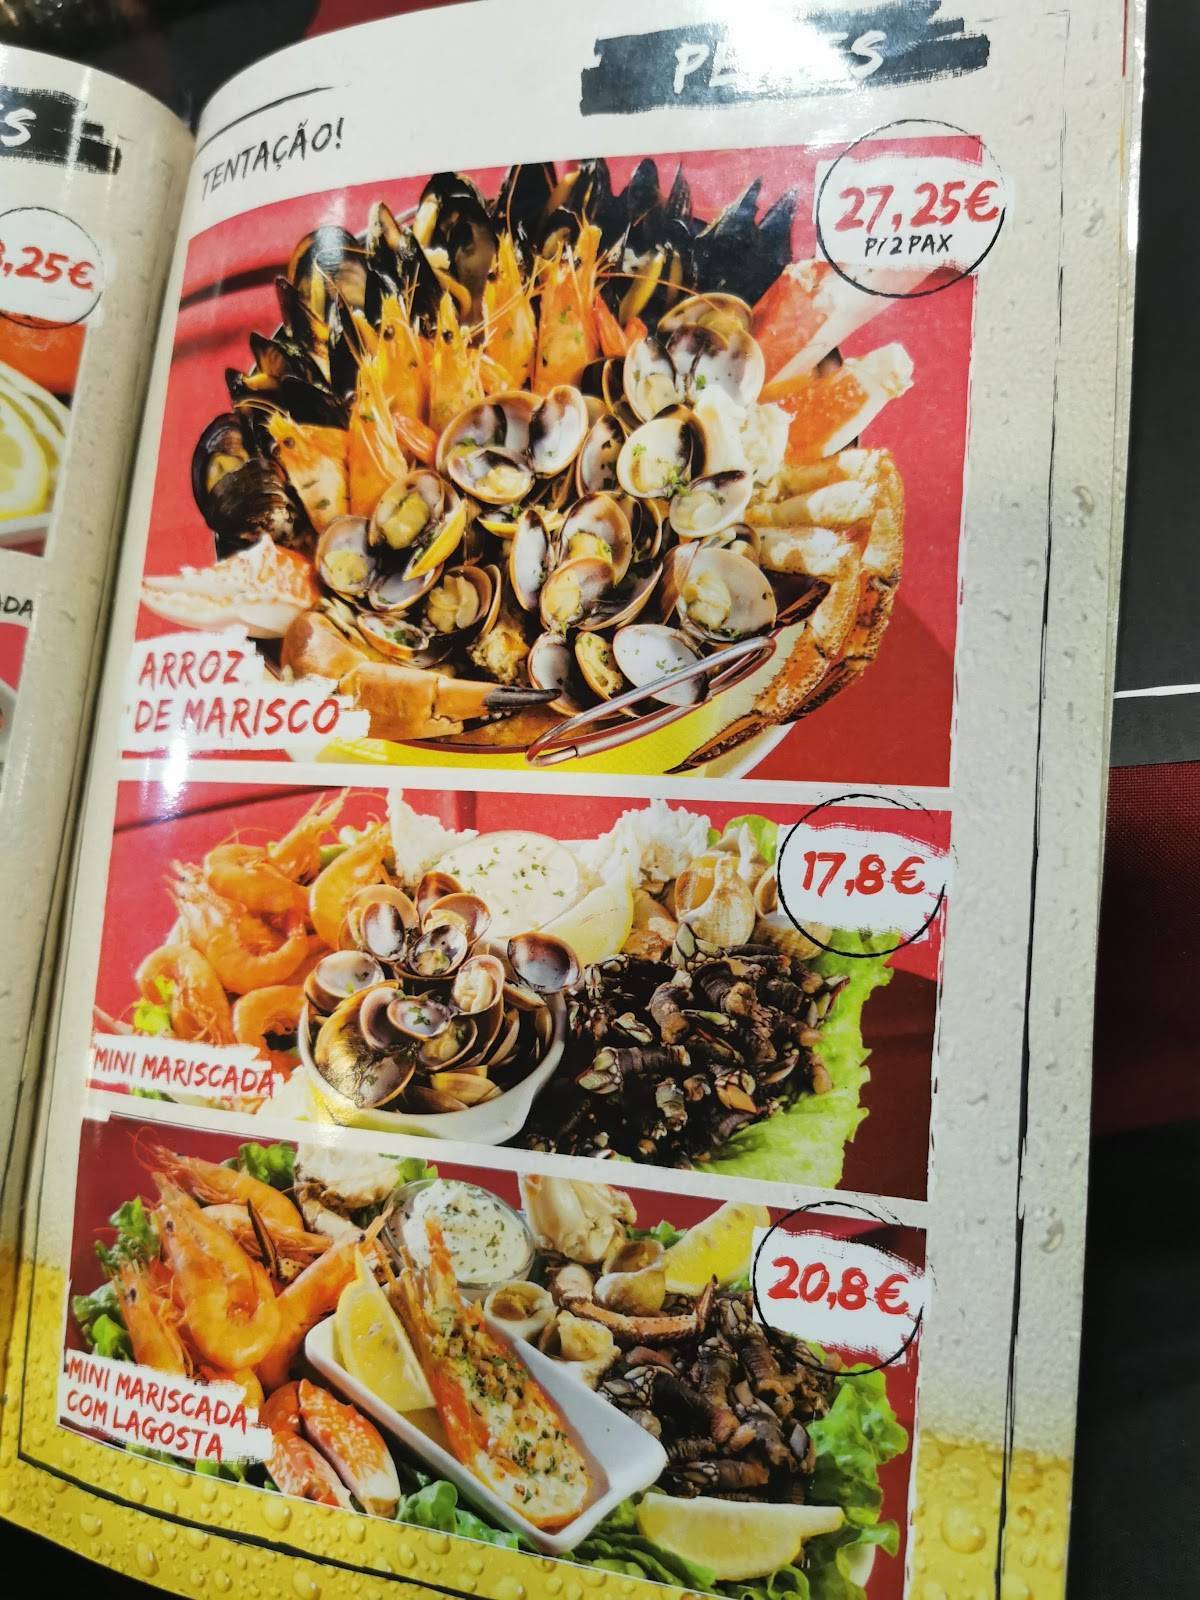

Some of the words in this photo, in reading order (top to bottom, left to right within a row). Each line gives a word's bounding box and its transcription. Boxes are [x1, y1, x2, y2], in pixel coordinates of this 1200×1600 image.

[202, 116, 345, 200] TENTAÇÃO!
[834, 179, 1000, 235] 27,25€
[908, 233, 953, 256] PAX
[138, 650, 244, 690] ARROZ
[134, 699, 174, 734] DE
[181, 696, 340, 738] MARISCO
[802, 850, 926, 898] 17,8€
[93, 1047, 136, 1076] MINI
[141, 1053, 276, 1099] MARISCADA
[766, 1256, 910, 1315] 20,8€
[67, 1356, 111, 1392] MINI
[115, 1372, 248, 1434] MARISCADA
[67, 1389, 109, 1426] COM
[112, 1405, 223, 1463] LAGOSTA
